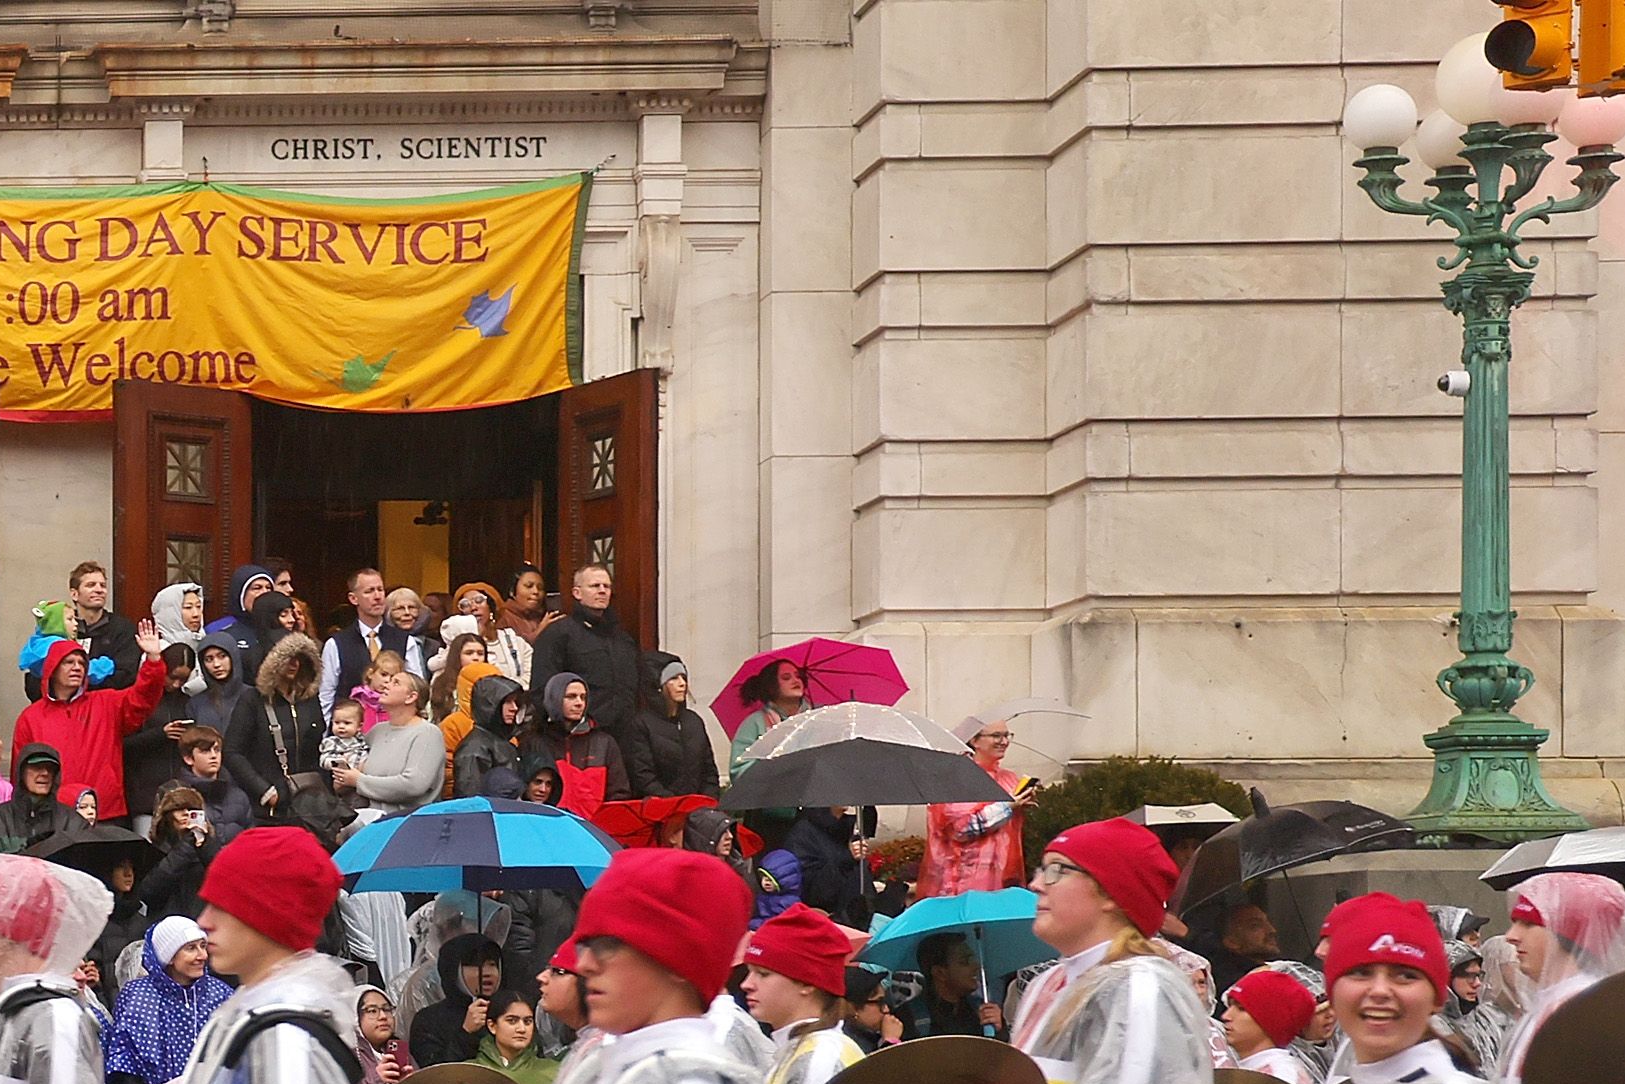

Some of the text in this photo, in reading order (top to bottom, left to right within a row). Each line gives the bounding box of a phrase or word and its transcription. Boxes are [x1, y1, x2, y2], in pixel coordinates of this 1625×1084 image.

[271, 136, 547, 161] CHRIST, SCIENTIST
[94, 211, 226, 262] DAY
[237, 215, 490, 265] SERVICE
[97, 286, 171, 322] am
[26, 336, 257, 388] Welcome
